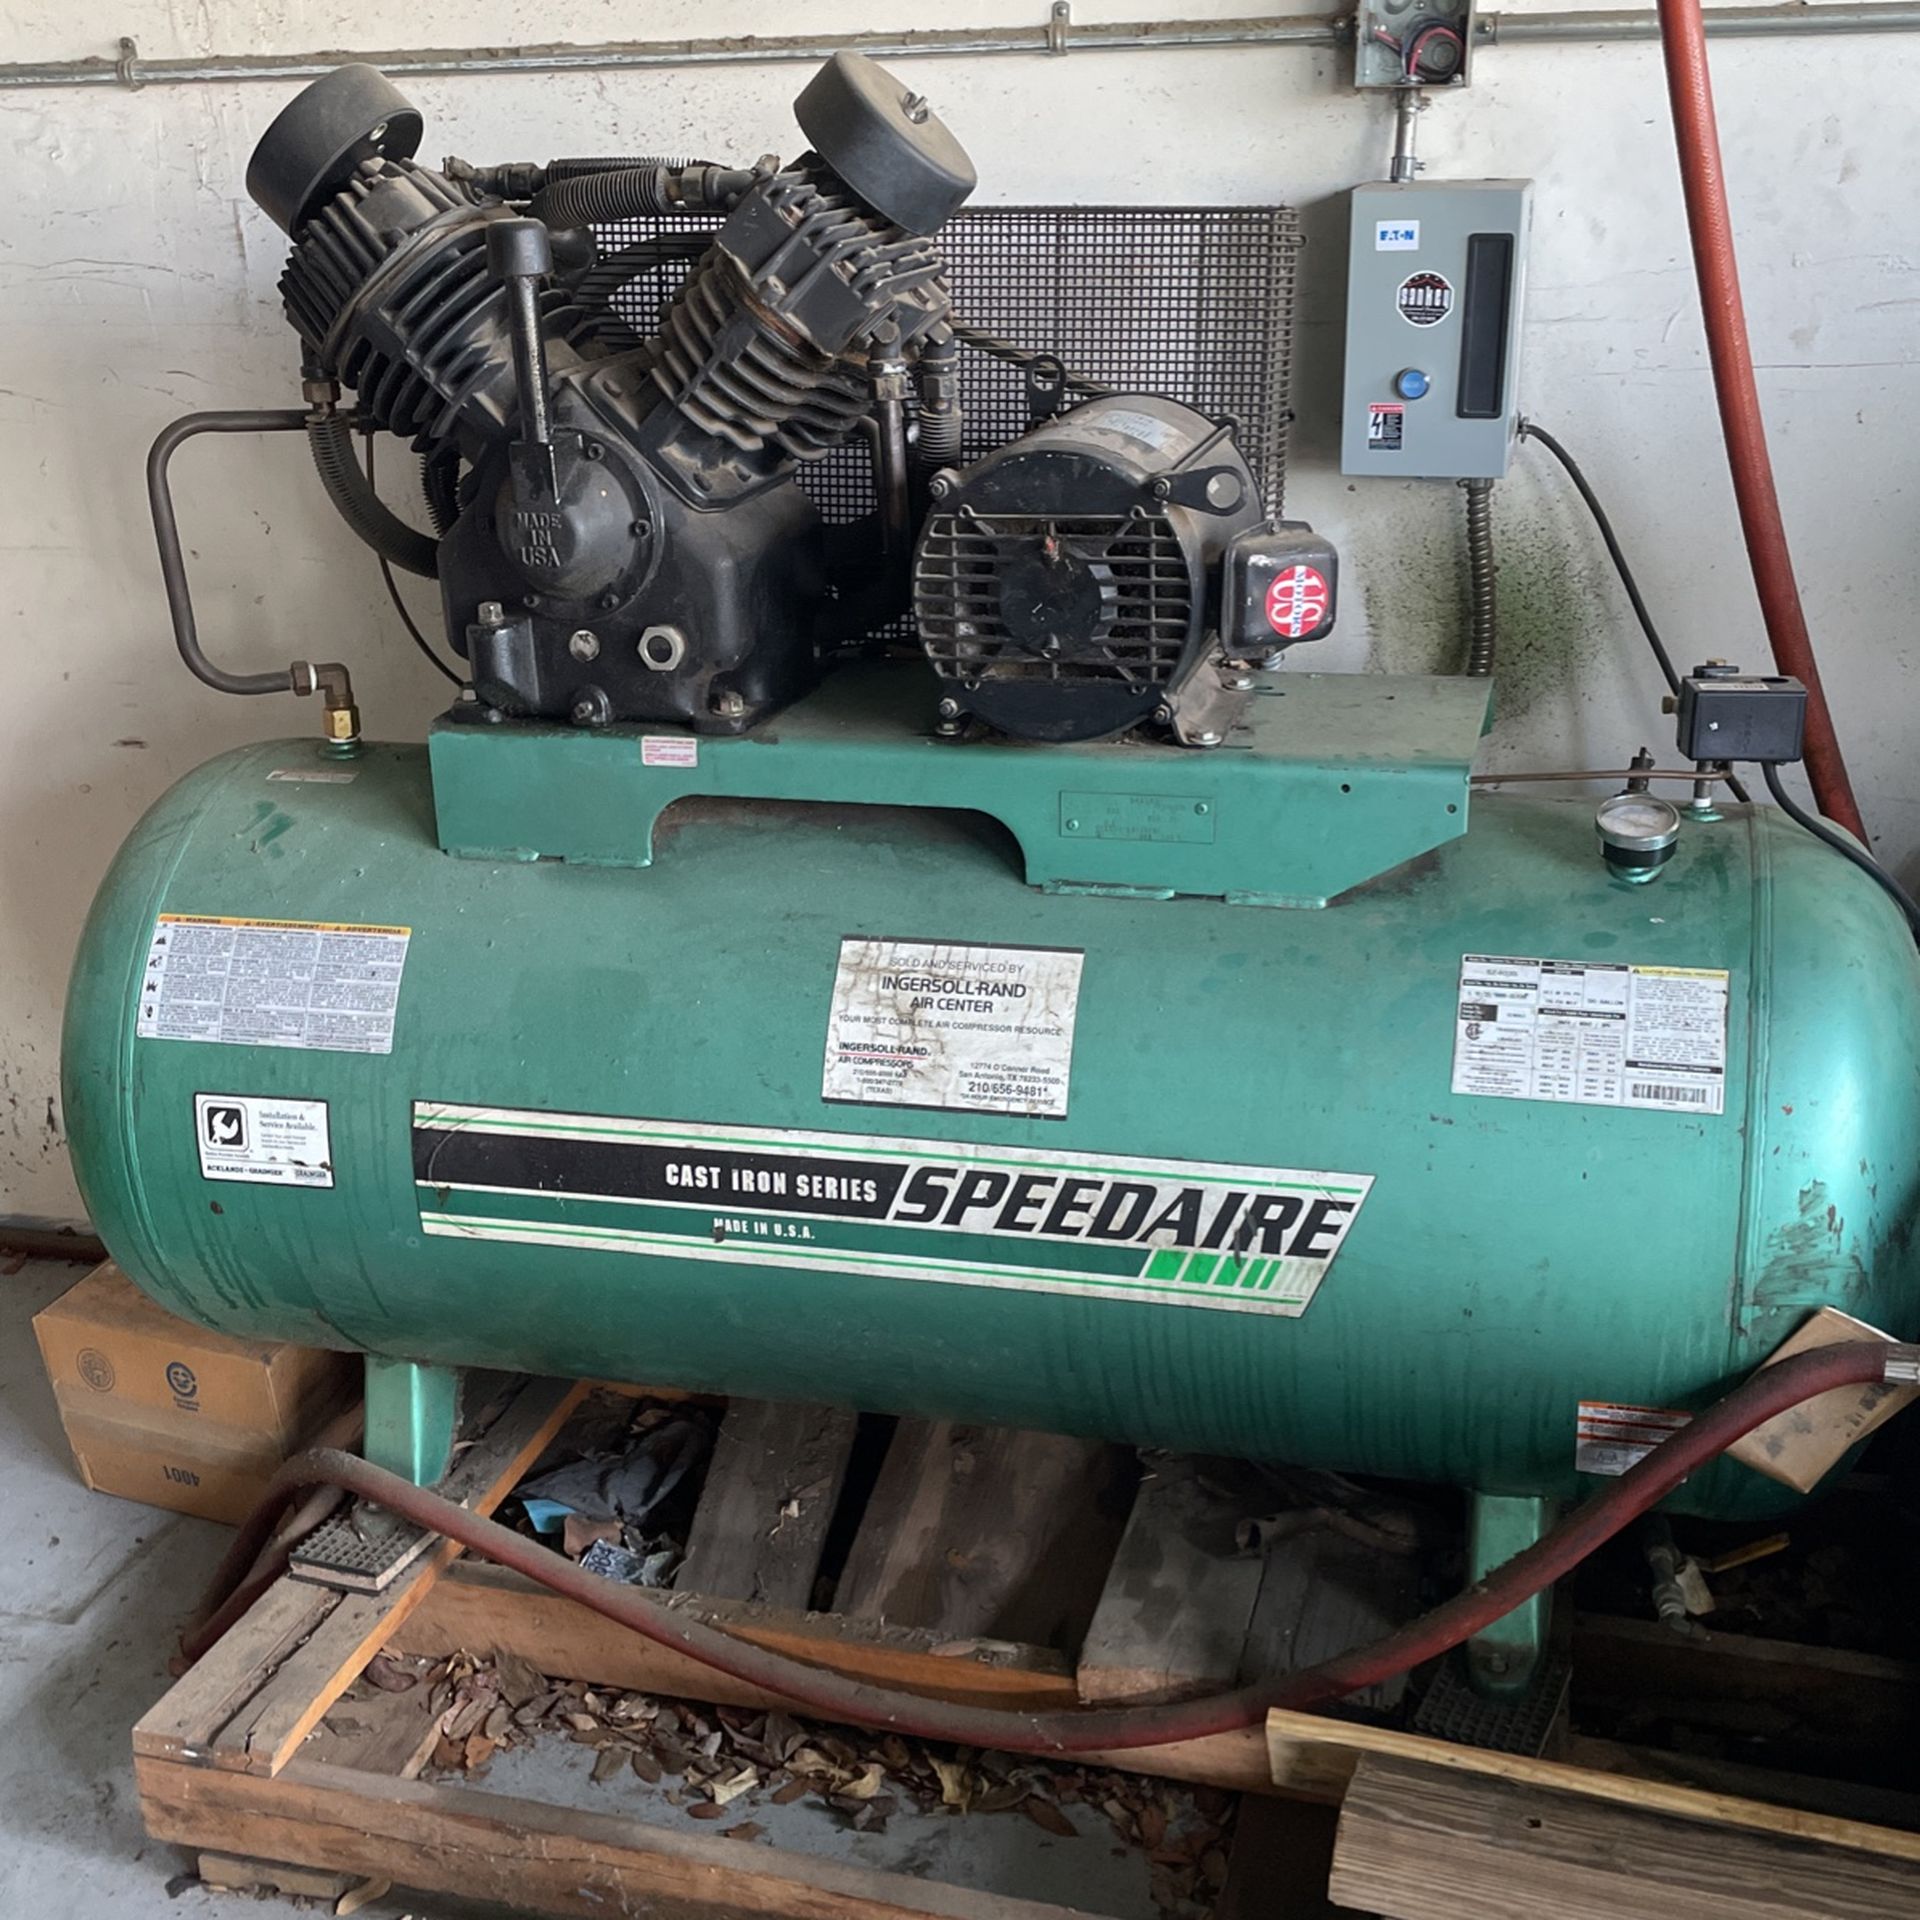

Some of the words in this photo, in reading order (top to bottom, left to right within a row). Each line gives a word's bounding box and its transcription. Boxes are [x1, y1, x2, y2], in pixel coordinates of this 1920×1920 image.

[517, 512, 562, 529] MADE
[531, 529, 552, 546] IN
[521, 547, 561, 567] USA
[1292, 572, 1305, 635] MOTORS
[891, 957, 921, 968] SOLD
[922, 958, 946, 970] AND
[948, 960, 1006, 973] SERVICED
[1009, 963, 1024, 973] BY
[882, 976, 1027, 998] INGERSOLL-RAND
[910, 996, 935, 1010] AIR
[937, 998, 993, 1013] CENTER
[838, 1015, 861, 1024] YOUR
[863, 1015, 887, 1025] MOST
[889, 1017, 933, 1028] COMPLETE
[936, 1020, 950, 1028] AIR
[952, 1021, 1012, 1033] COMPRESSOR
[1014, 1025, 1062, 1036] RESOURCE
[853, 1057, 914, 1069] COMPRESSORS
[959, 1070, 973, 1078] San
[259, 1120, 284, 1129] Service
[665, 1163, 722, 1190] CAST
[731, 1168, 788, 1195] IRON
[795, 1174, 878, 1202] SERIES
[893, 1166, 1356, 1260] SPEEDAIRE
[713, 1217, 748, 1235] MADE
[754, 1221, 770, 1236] IN
[774, 1222, 816, 1239] U.S.A.
